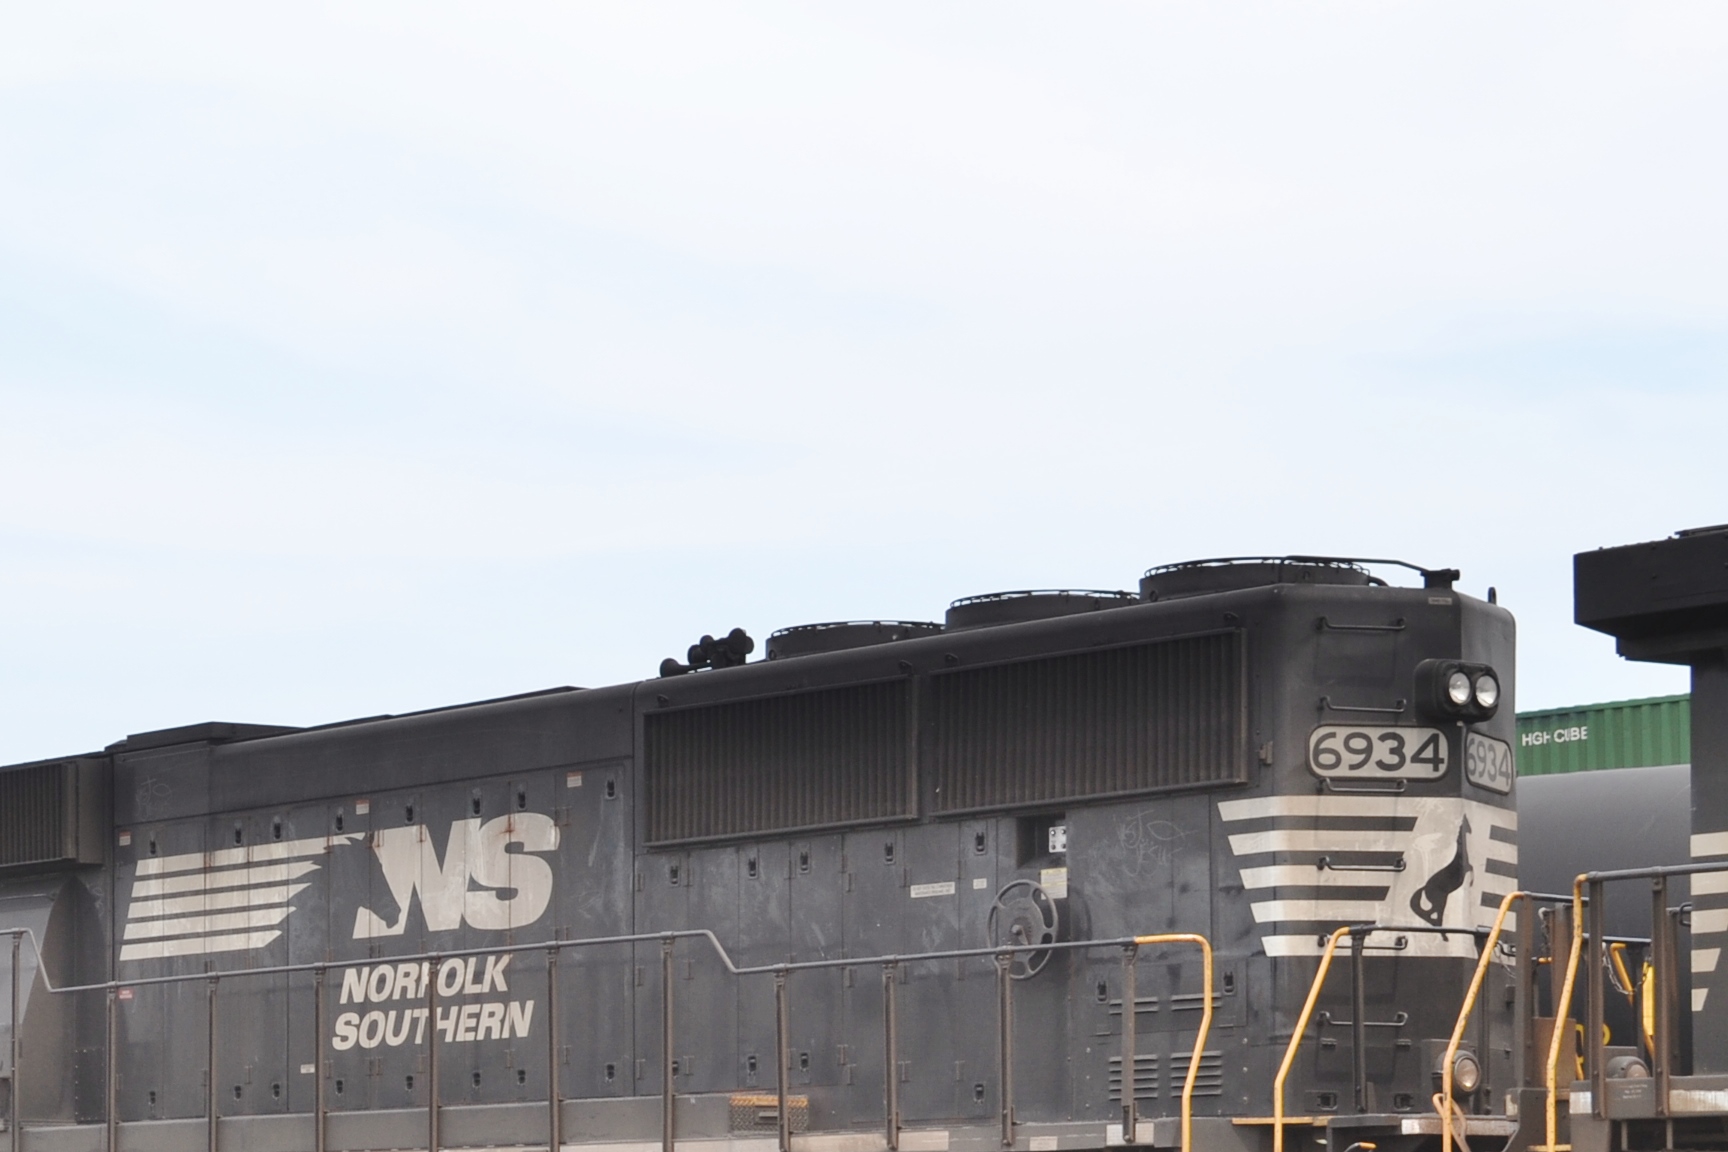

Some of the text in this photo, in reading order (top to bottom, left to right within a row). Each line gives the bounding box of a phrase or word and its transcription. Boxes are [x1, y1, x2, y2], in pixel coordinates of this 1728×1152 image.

[1312, 731, 1445, 772] 6934
[1521, 726, 1588, 746] HGH CUBE
[1467, 738, 1511, 786] 6934
[339, 954, 513, 1004] NORFOLK
[332, 1000, 534, 1050] SOUTHERN
